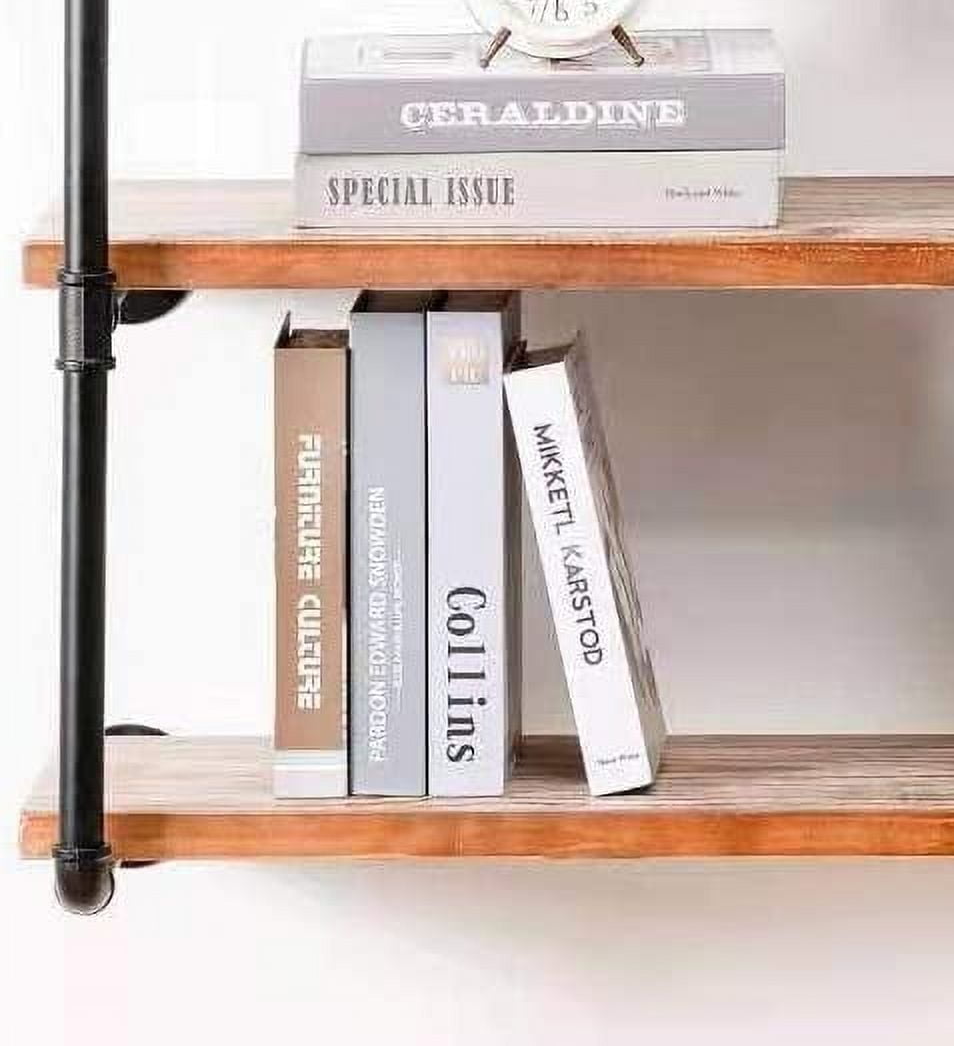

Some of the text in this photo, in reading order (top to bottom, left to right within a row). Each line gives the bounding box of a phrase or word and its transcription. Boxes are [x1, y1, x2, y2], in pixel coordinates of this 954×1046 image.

[328, 176, 516, 207] SPECIAL ISSUE
[367, 486, 386, 763] PARDON EDWARD SNOWDEN
[445, 585, 487, 765] Collins
[562, 542, 605, 668] KARSTOD
